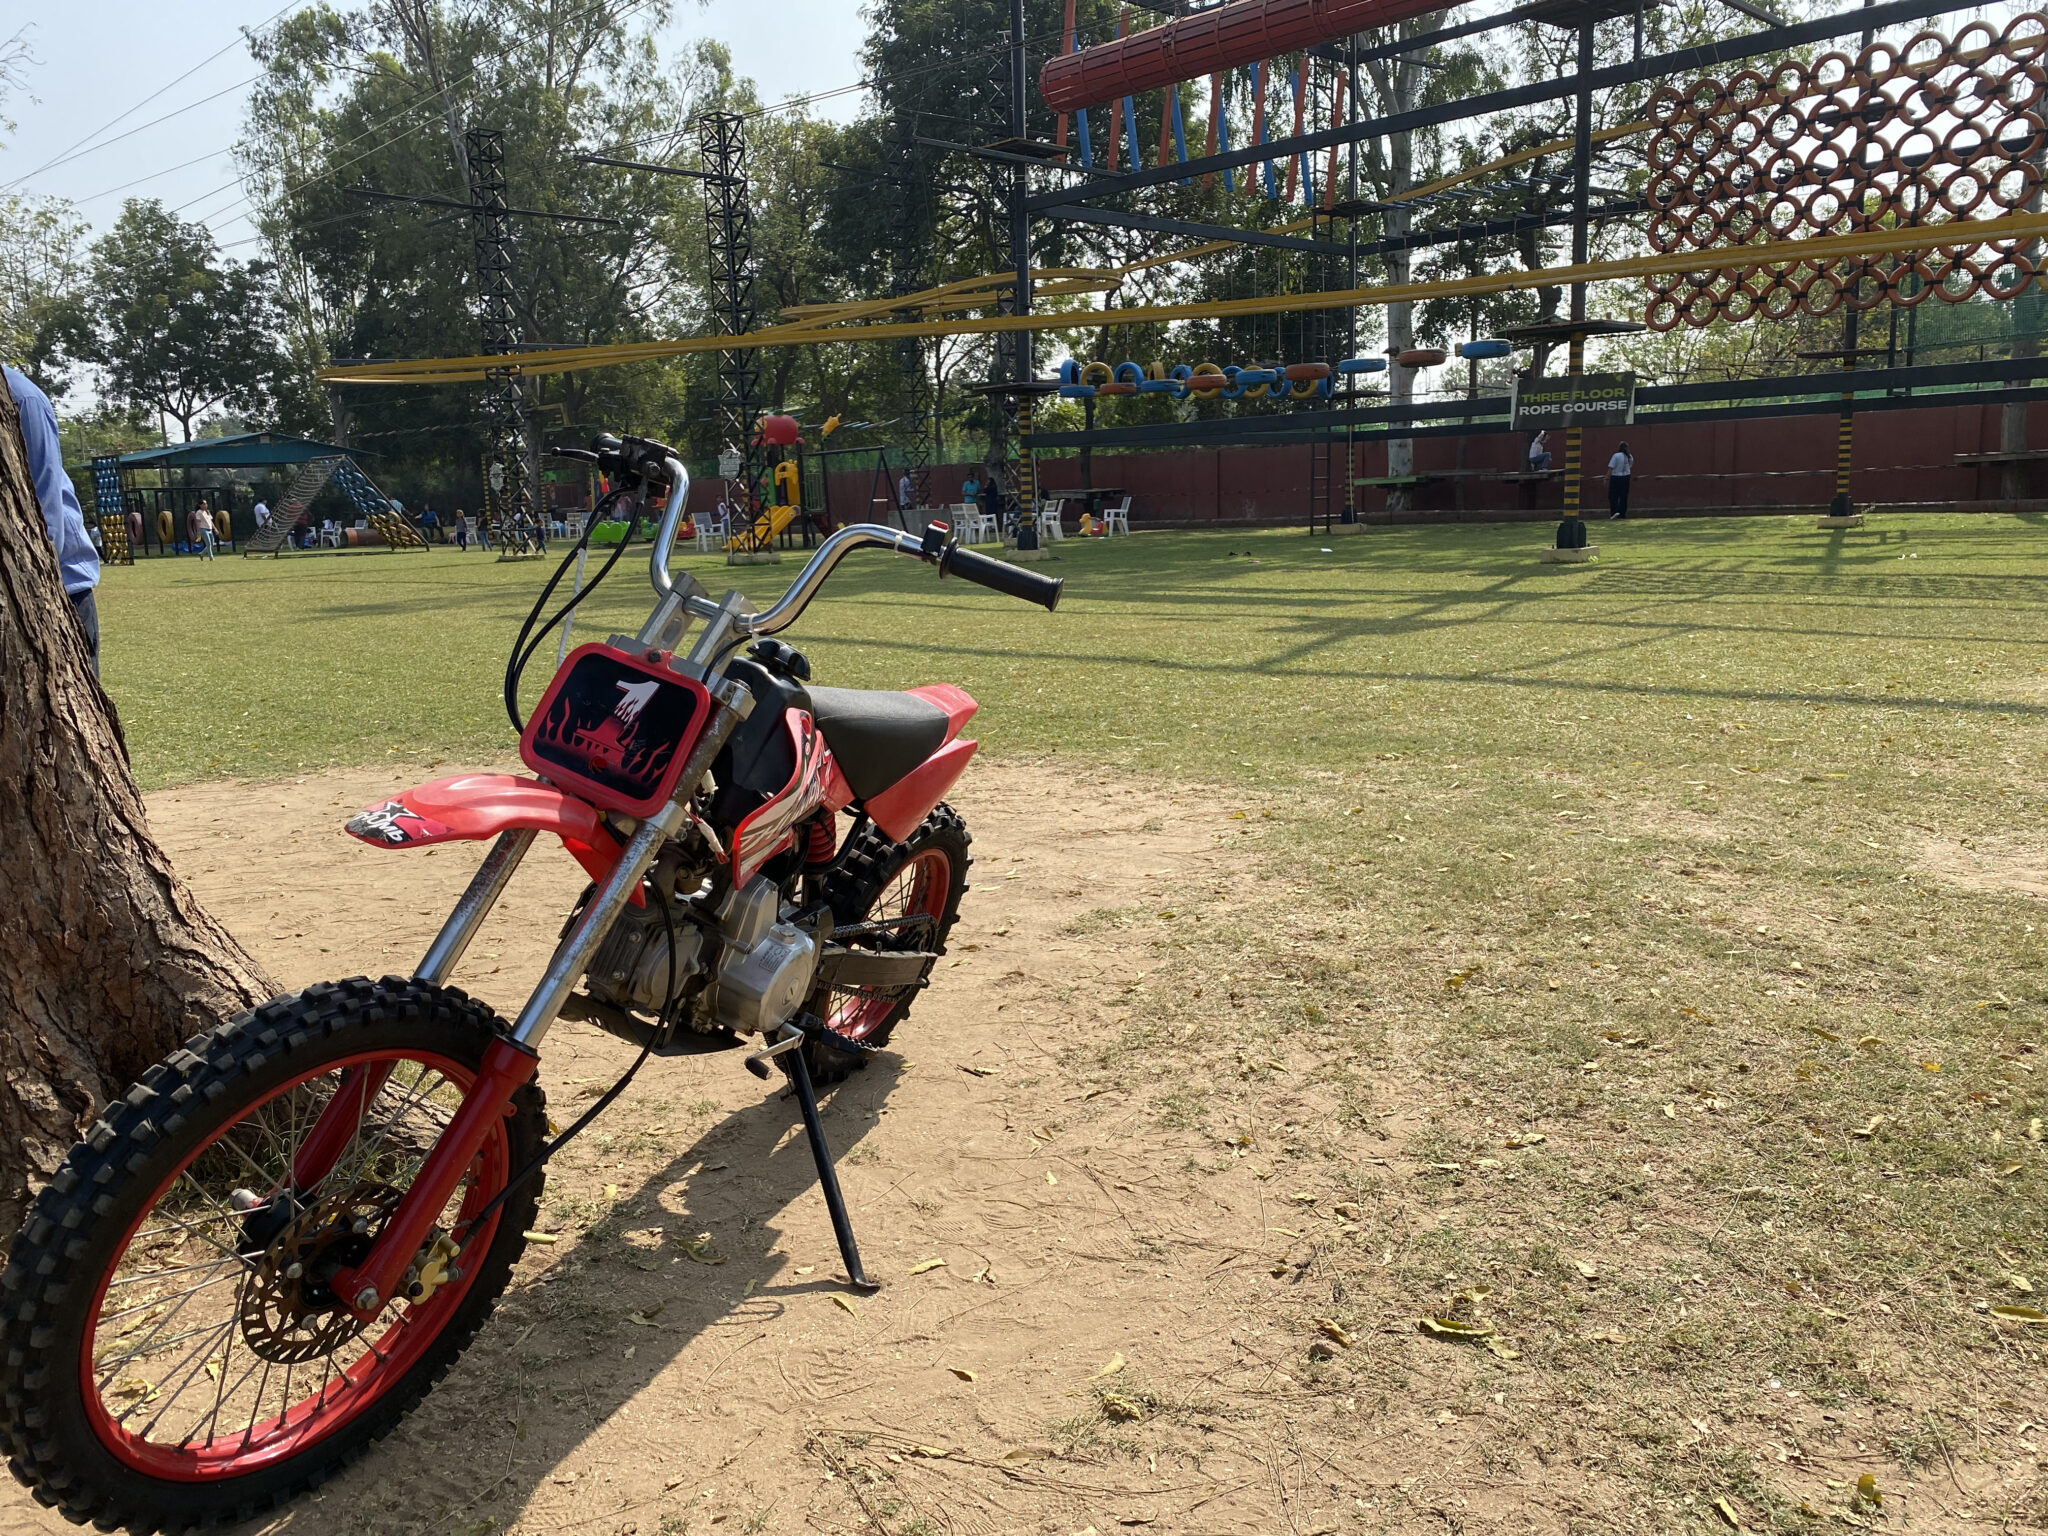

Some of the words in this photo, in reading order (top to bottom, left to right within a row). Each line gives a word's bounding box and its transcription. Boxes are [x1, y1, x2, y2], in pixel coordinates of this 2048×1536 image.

[1521, 391, 1569, 403] THREE
[1572, 387, 1626, 401] FLOOR
[1519, 404, 1561, 416] ROPE
[1562, 400, 1628, 413] COURSE
[574, 679, 661, 753] 1
